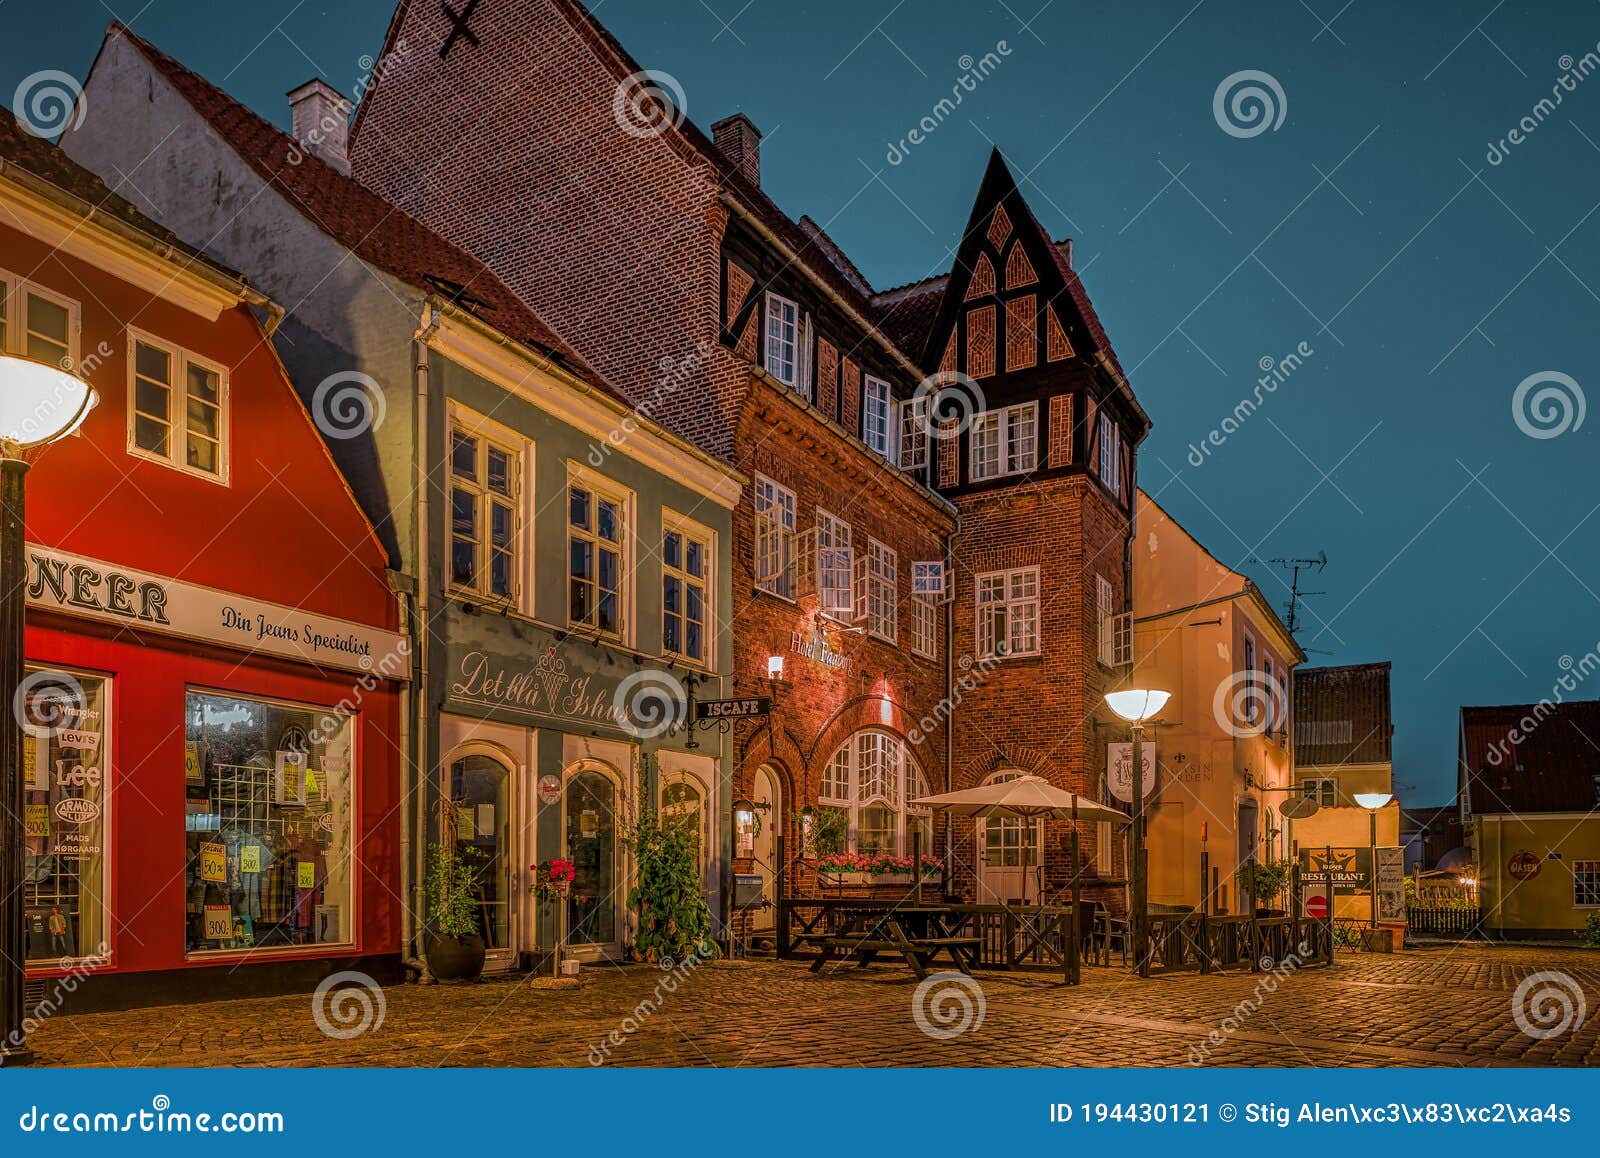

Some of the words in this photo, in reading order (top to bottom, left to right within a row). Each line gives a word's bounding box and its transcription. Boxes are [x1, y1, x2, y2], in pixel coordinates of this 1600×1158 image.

[25, 554, 170, 625] NEER
[222, 606, 252, 631] Din
[256, 614, 299, 640] Jeans
[303, 624, 370, 652] Specialist
[790, 631, 818, 660] Hotel
[452, 652, 504, 696] Det
[506, 673, 541, 706] blå
[58, 705, 99, 720] Wrangler
[56, 760, 100, 787] Lee
[60, 801, 97, 812] ARMOR
[54, 845, 100, 853] NØRGAARD
[1301, 873, 1365, 881] RESTURANT
